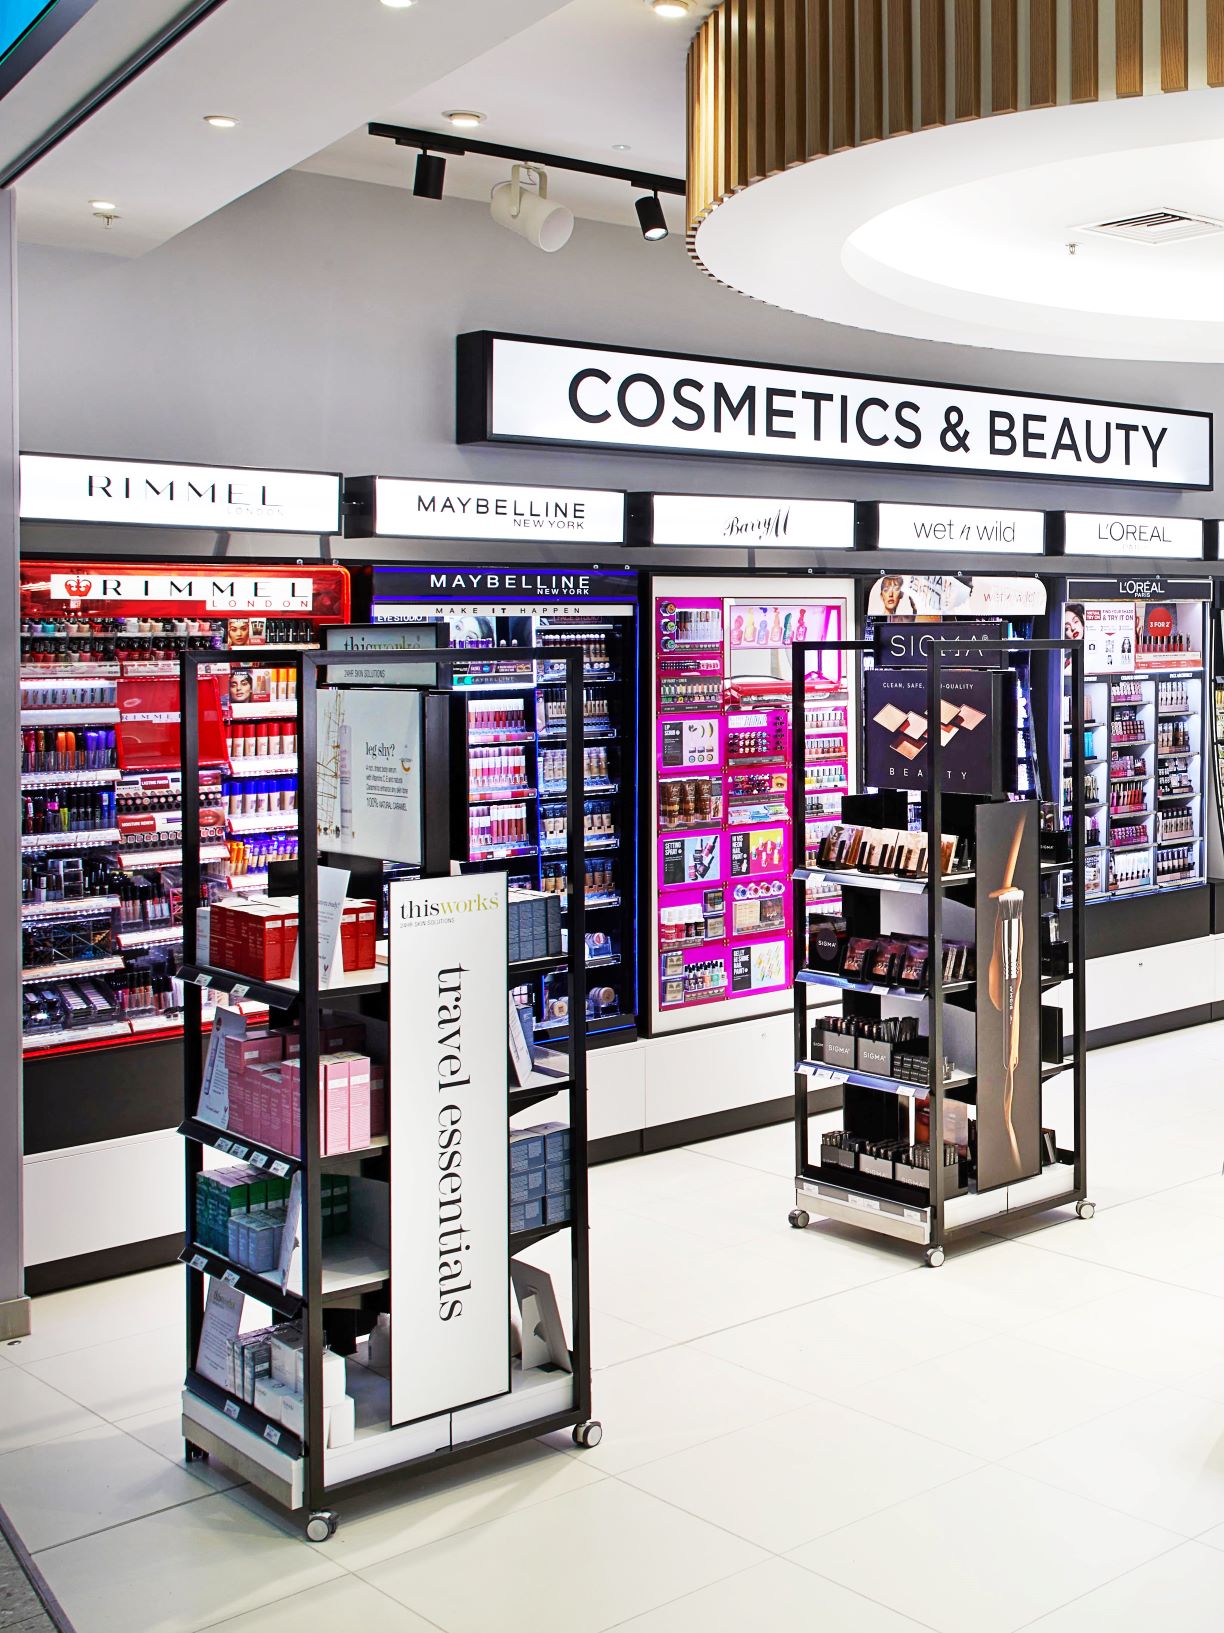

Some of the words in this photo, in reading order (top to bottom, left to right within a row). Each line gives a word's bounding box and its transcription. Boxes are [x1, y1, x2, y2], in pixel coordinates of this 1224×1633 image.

[568, 367, 922, 450] COSMETICS
[939, 405, 970, 454] &
[989, 410, 1168, 468] BEAUTY
[88, 475, 284, 507] RIMMEL
[417, 495, 585, 519] MAYBELLINE
[513, 519, 544, 528] NEW
[549, 520, 585, 530] YORK
[913, 519, 953, 540] wet
[960, 523, 971, 541] n
[977, 521, 1016, 542] wild
[102, 579, 309, 598] RIMMEL
[430, 574, 590, 589] MAYBELLINE
[365, 742, 377, 758] leg
[378, 743, 395, 760] shy?
[890, 768, 967, 780] BEATY
[437, 961, 472, 1094] travel
[828, 1045, 850, 1054] SIGMA
[864, 1051, 886, 1061] SIGMA
[437, 1104, 472, 1322] essentials
